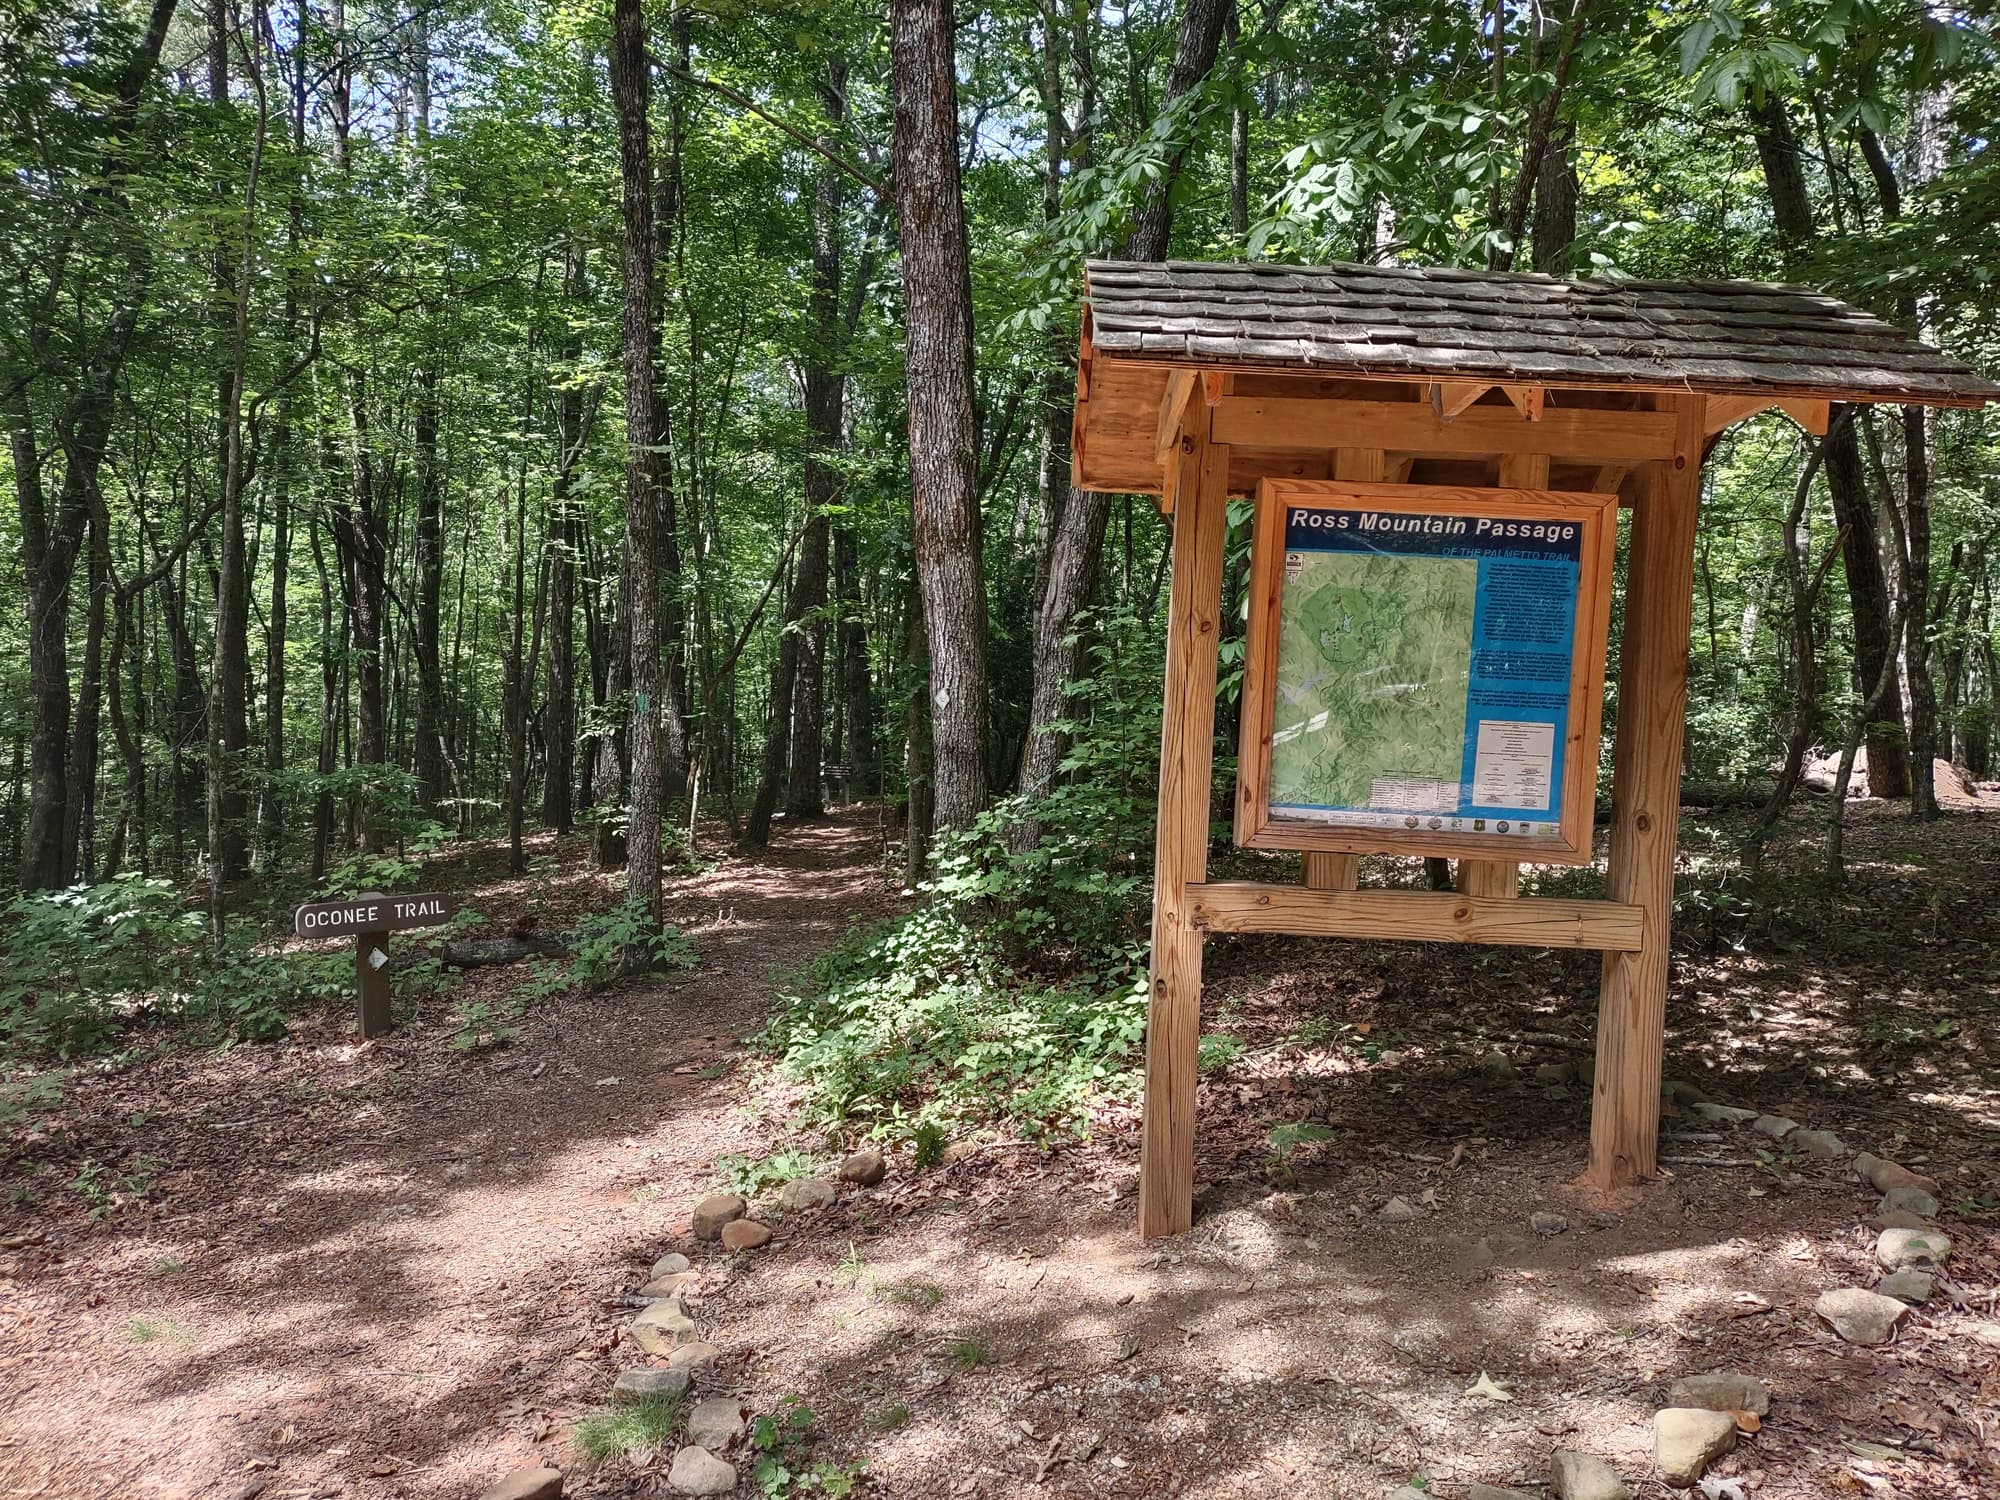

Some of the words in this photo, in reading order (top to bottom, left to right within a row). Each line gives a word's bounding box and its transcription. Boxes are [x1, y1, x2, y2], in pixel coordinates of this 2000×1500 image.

[1291, 509, 1349, 529] Ross
[1359, 512, 1467, 535] Mountain
[1475, 518, 1574, 543] Passage
[1442, 546, 1458, 557] OF
[1460, 547, 1481, 558] THE
[1483, 548, 1540, 561] PALMETTO
[1543, 551, 1570, 561] TRAIL
[304, 906, 378, 929] OCONEE
[393, 900, 445, 919] TRAIL
